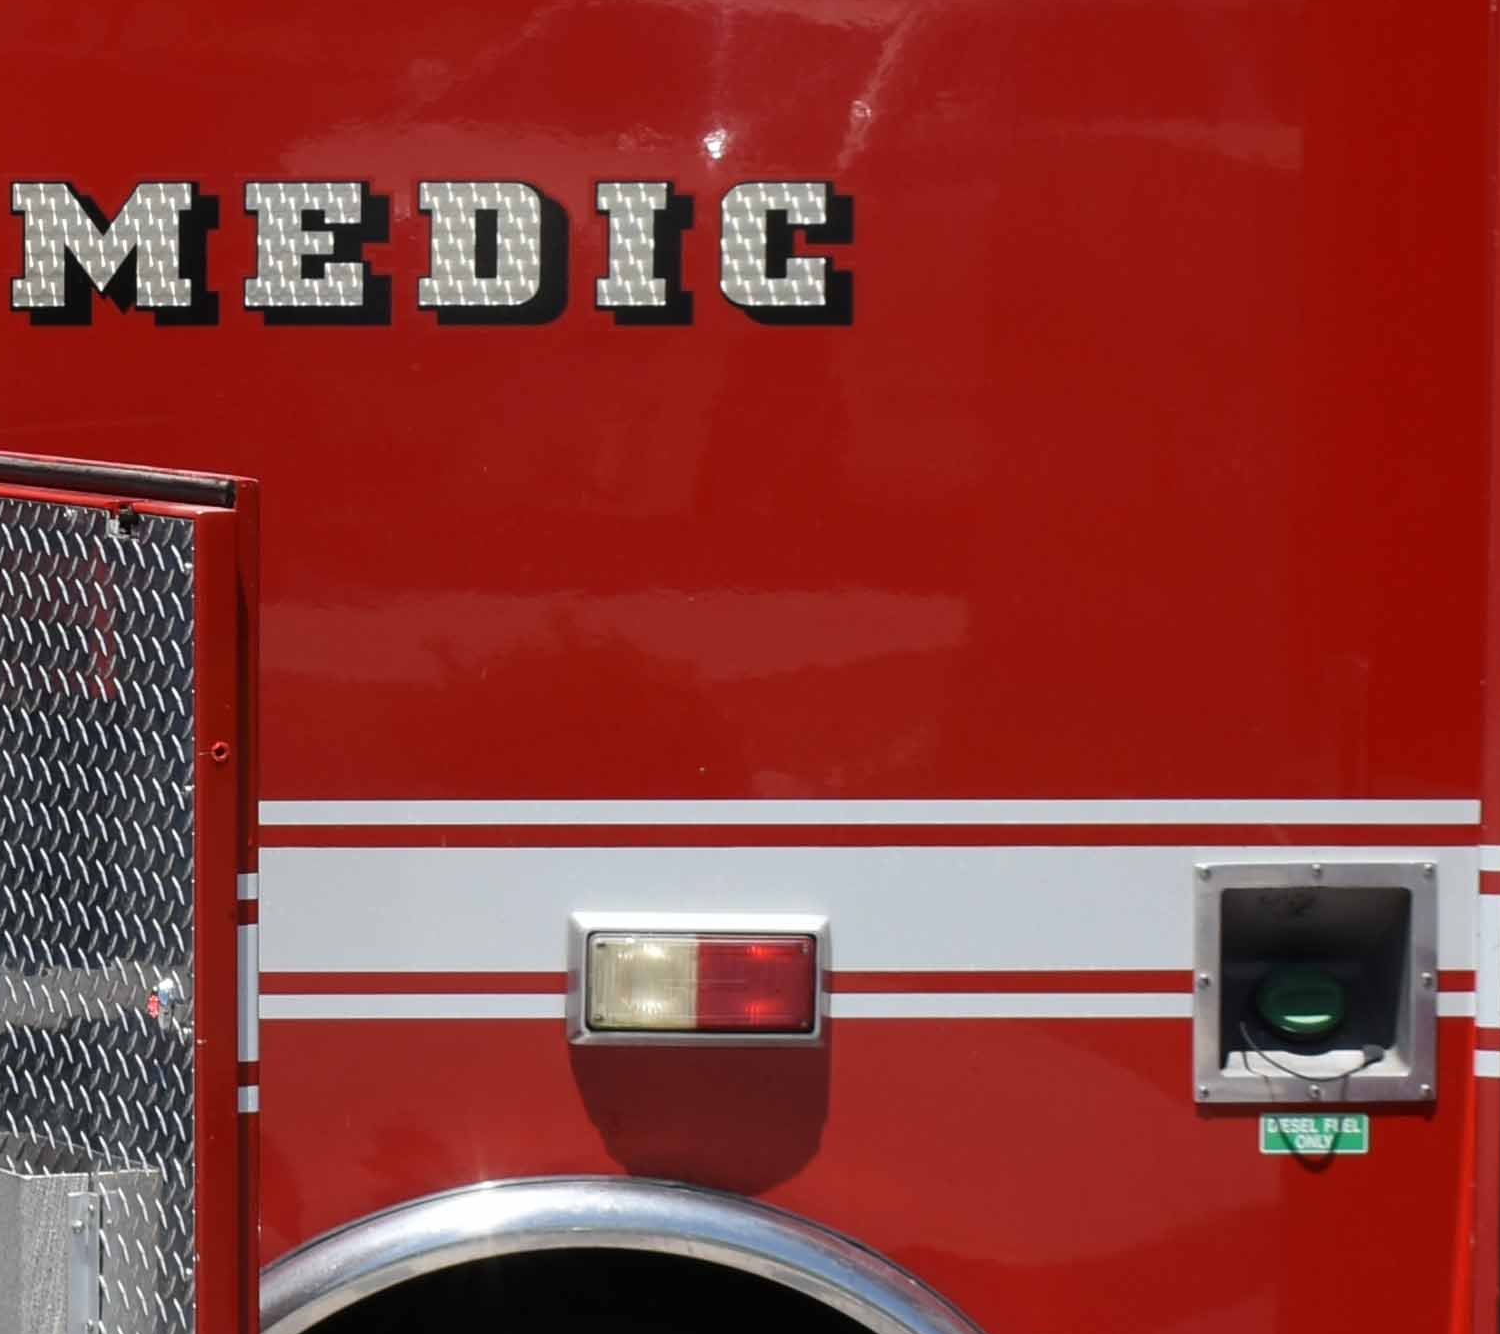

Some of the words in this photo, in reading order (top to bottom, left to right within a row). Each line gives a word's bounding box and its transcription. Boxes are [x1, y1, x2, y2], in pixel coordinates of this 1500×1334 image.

[1266, 1117, 1320, 1133] DIESEL
[1322, 1117, 1361, 1133] FUEL
[1294, 1133, 1334, 1149] ONLY
